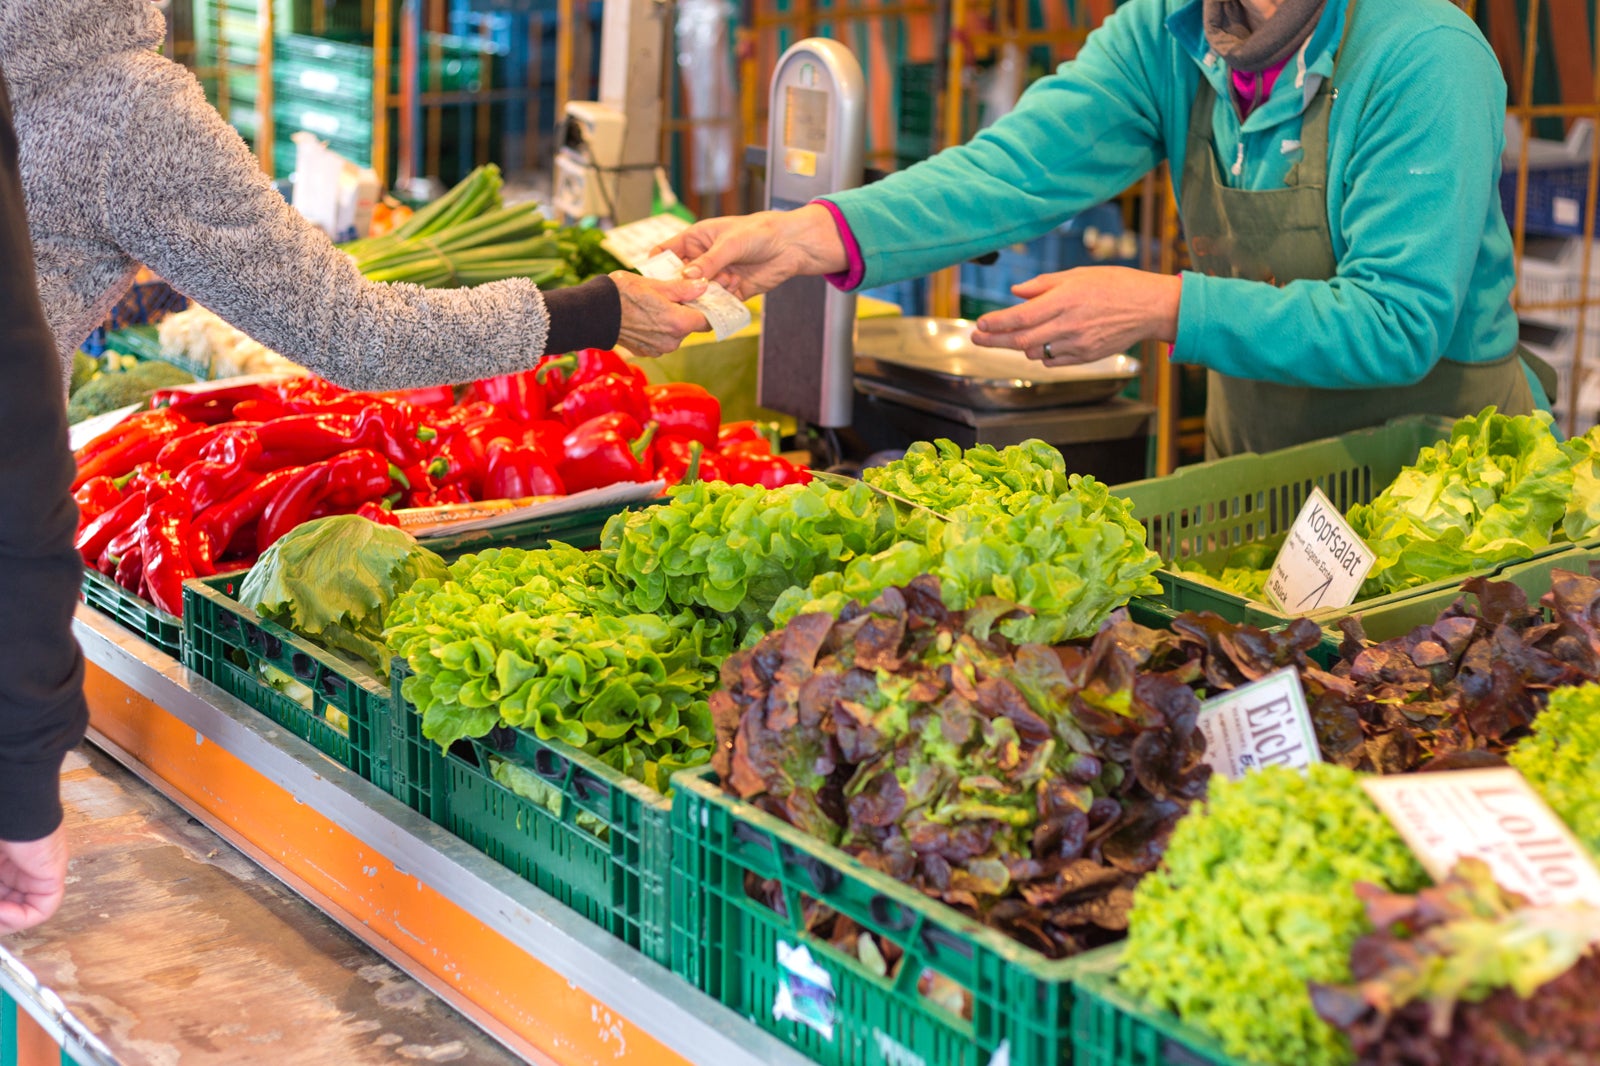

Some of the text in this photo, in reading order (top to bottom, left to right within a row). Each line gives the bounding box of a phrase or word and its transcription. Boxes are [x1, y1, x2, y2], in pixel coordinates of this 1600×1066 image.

[1307, 503, 1361, 577] Kopfsalat
[1245, 692, 1308, 771] Eich
[1472, 787, 1579, 888] Lollo
